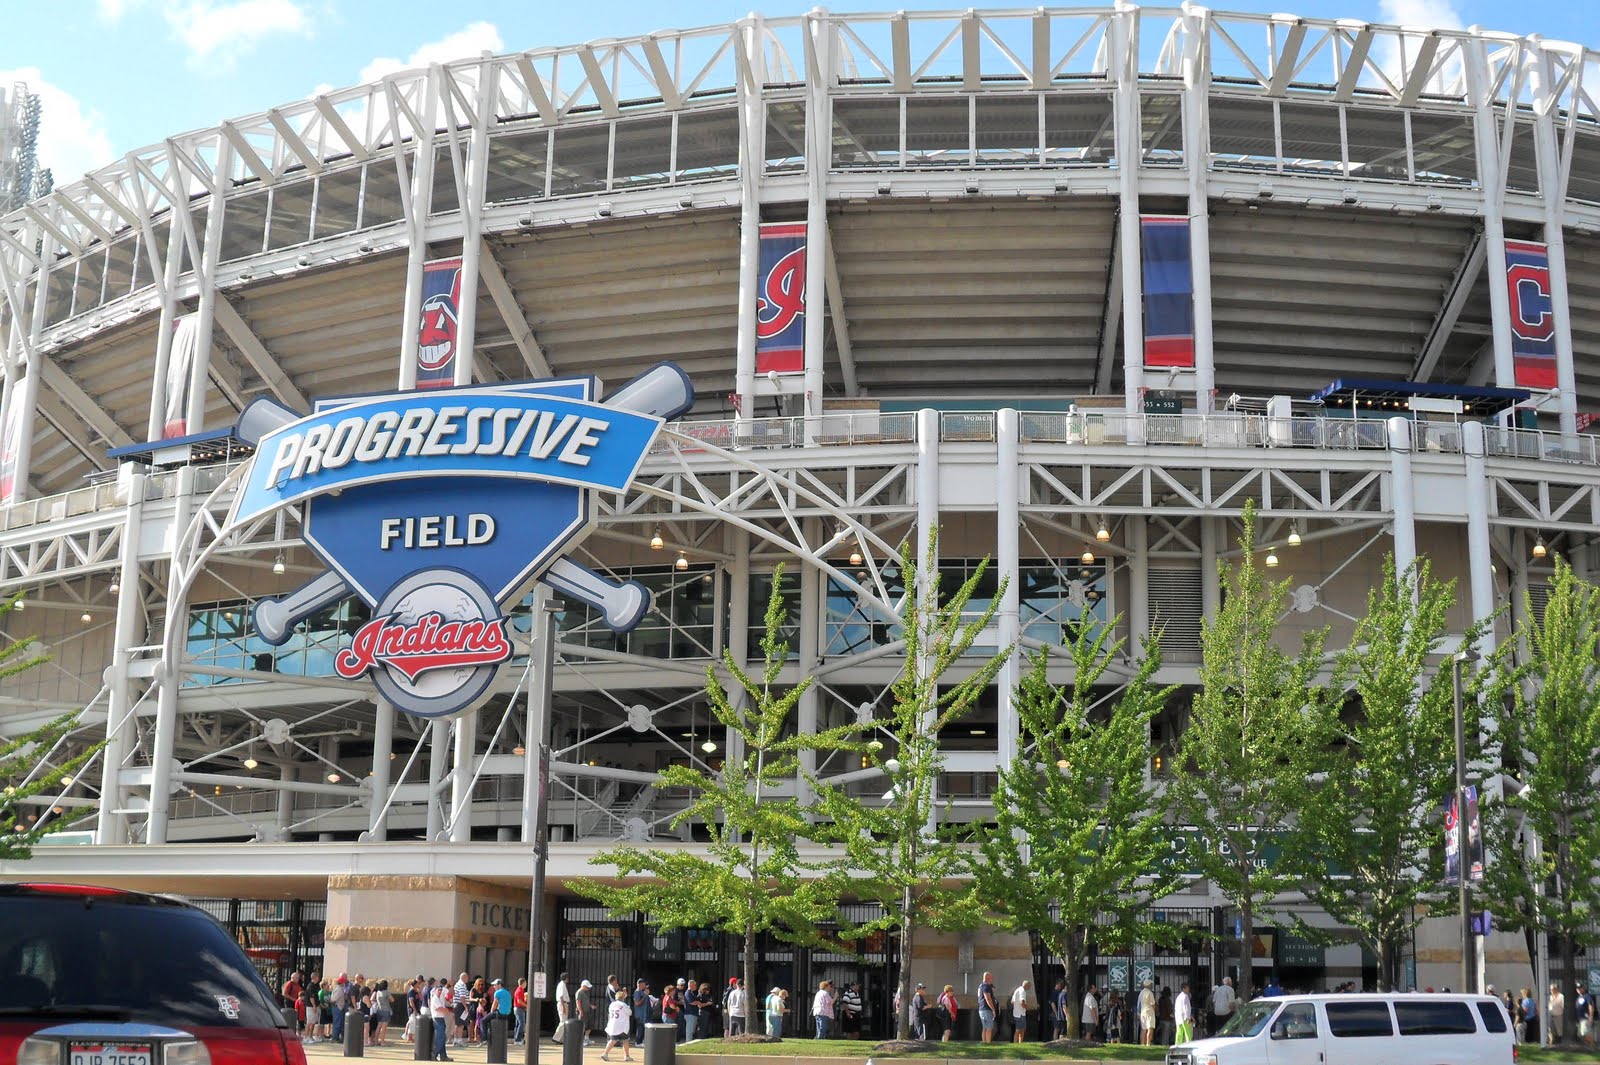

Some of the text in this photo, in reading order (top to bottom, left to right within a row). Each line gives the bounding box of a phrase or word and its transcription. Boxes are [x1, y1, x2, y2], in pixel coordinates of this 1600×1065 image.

[265, 406, 610, 491] PROGRESSIVE
[380, 513, 496, 550] FIELD
[334, 612, 513, 684] Indians
